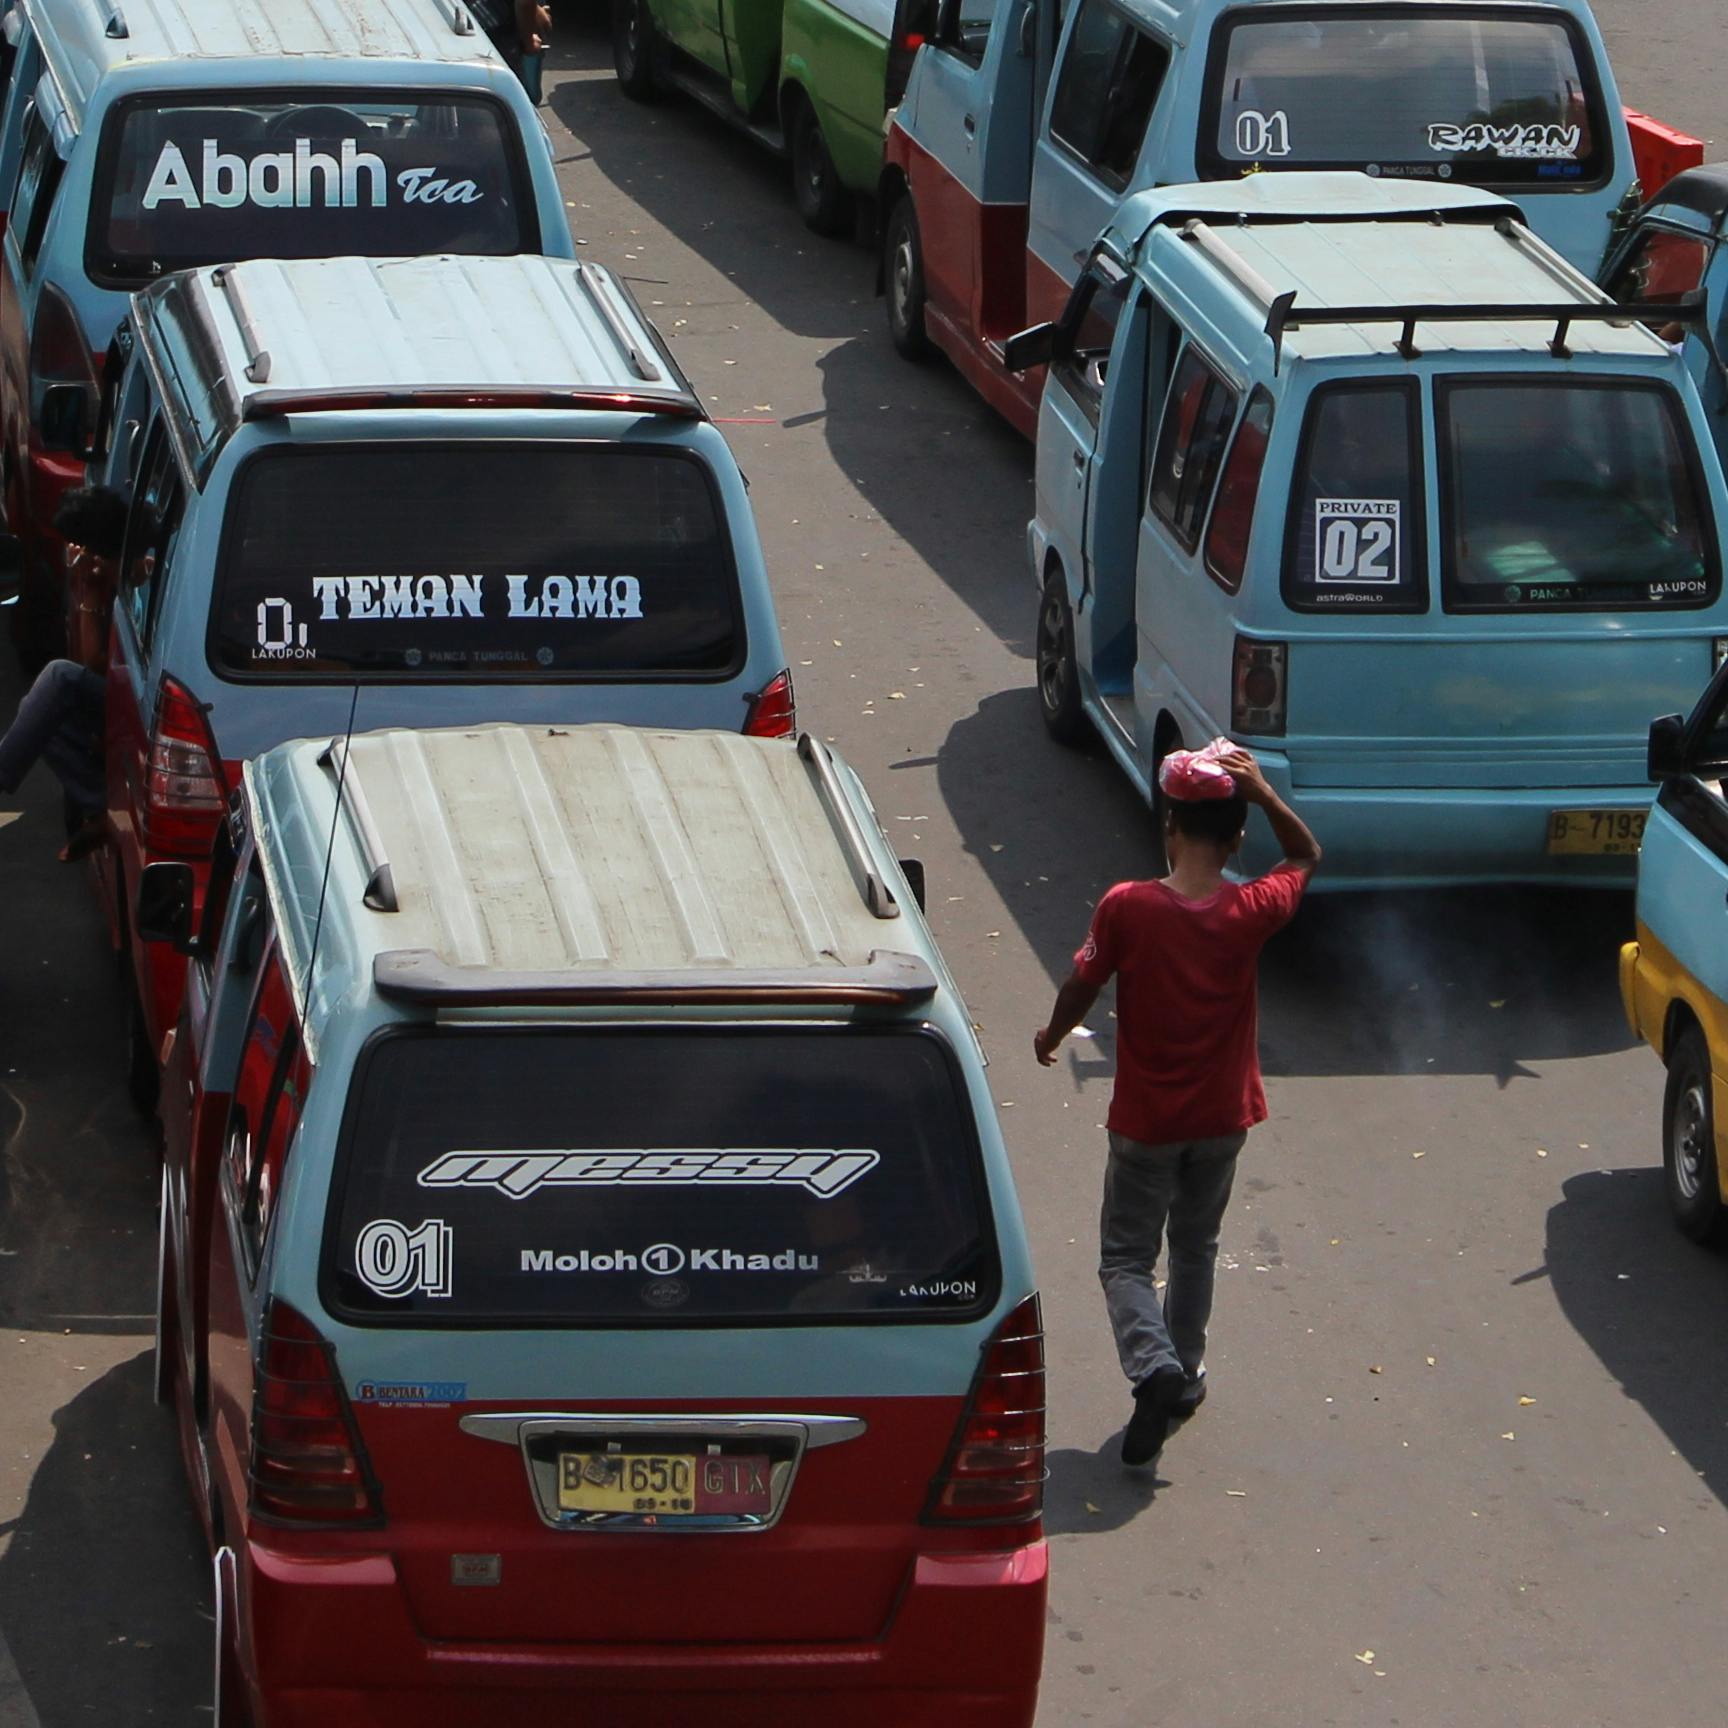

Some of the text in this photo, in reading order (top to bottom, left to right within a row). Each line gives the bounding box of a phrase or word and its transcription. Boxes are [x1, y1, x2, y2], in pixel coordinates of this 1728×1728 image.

[1236, 110, 1292, 156] 01
[1427, 123, 1581, 152] RAWAN
[142, 138, 387, 209] Abahh
[1319, 502, 1397, 514] PRIVATE
[1324, 520, 1392, 577] 02
[313, 574, 643, 620] TEMAN LAMA
[252, 648, 317, 659] LAKUPON
[429, 651, 528, 662] PANCA TUNGGAL
[1589, 813, 1646, 840] 7193
[416, 1149, 880, 1200] messy
[355, 1218, 454, 1299] 01
[521, 1249, 637, 1272] Moloh
[691, 1249, 819, 1271] Khadu
[563, 1456, 582, 1491] B
[704, 1461, 766, 1495] GTX
